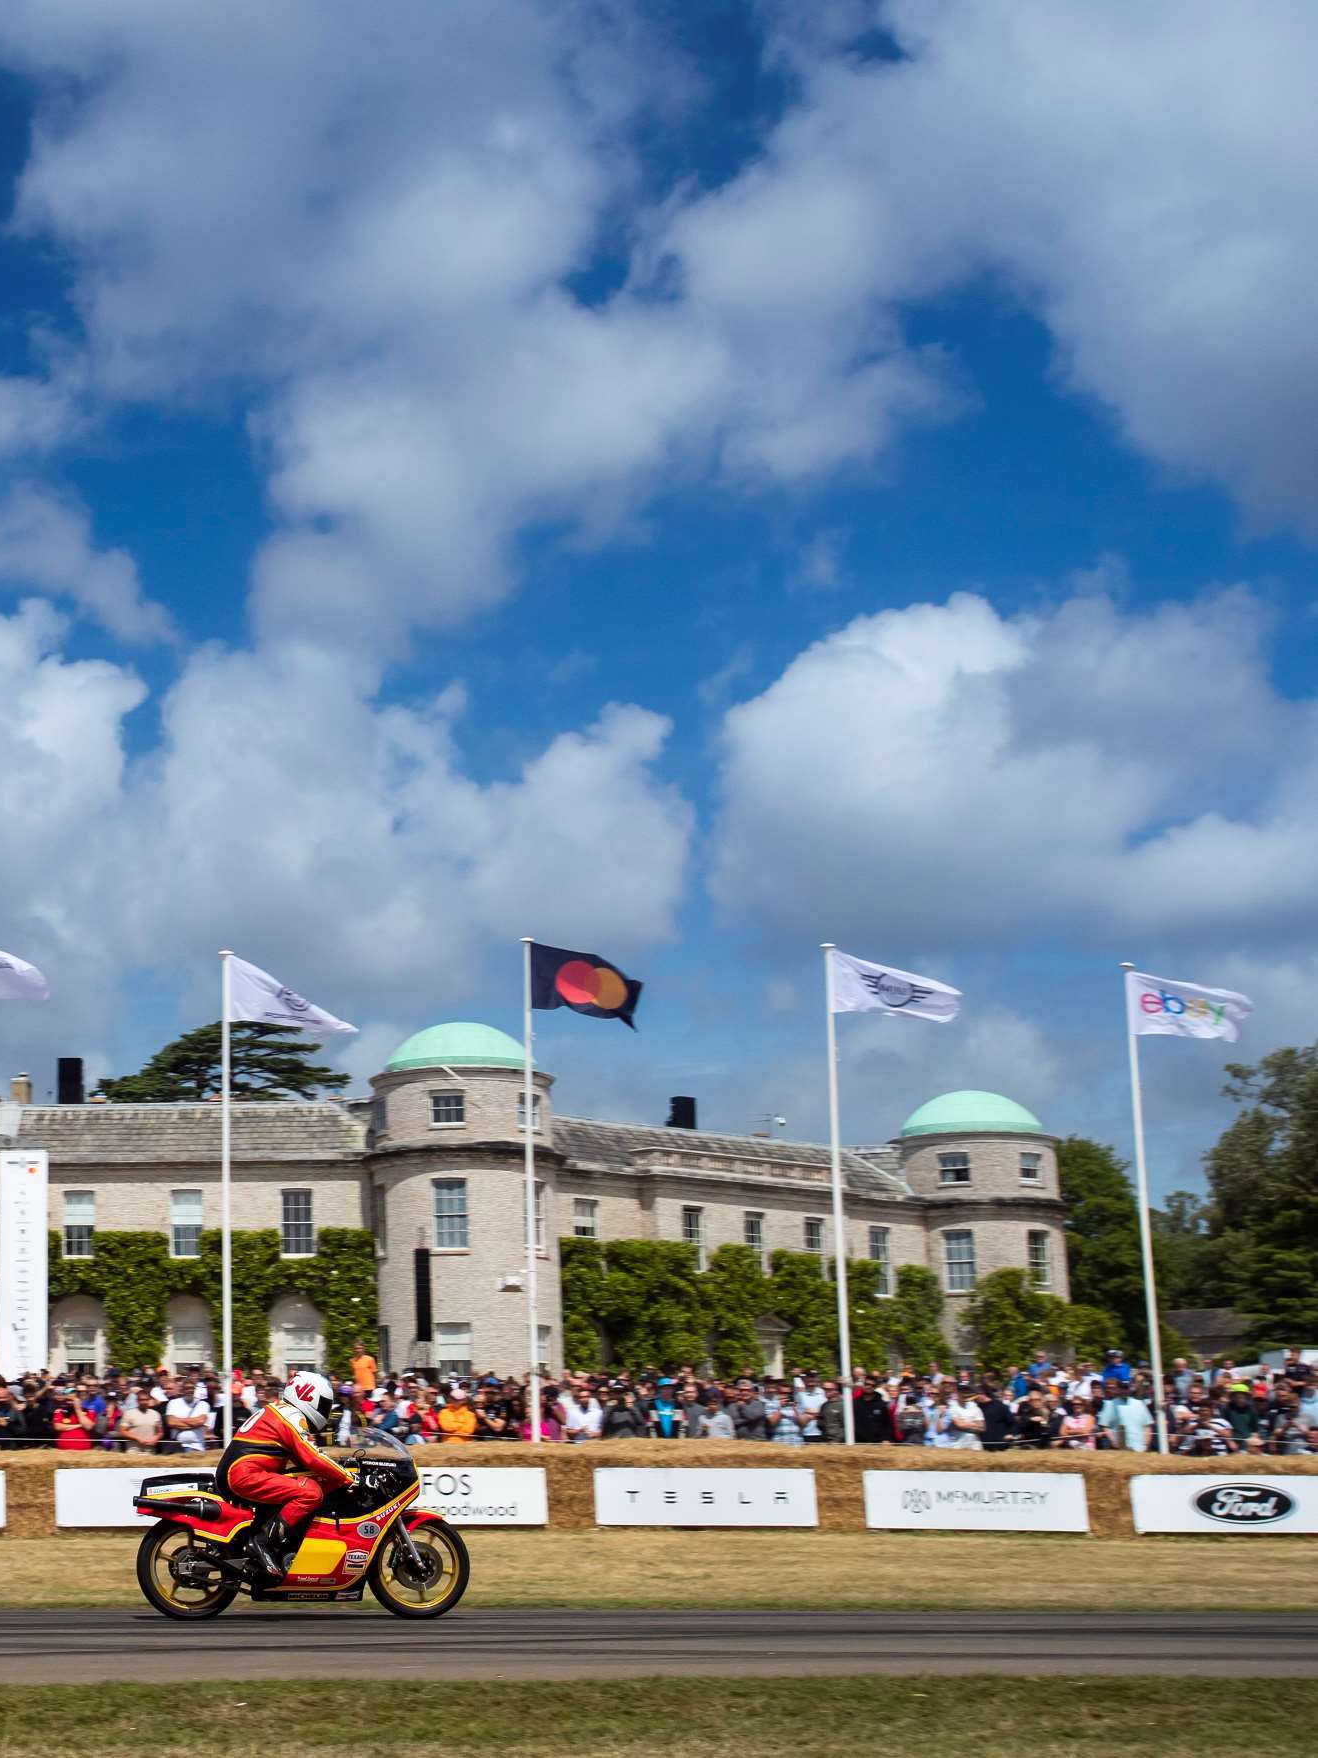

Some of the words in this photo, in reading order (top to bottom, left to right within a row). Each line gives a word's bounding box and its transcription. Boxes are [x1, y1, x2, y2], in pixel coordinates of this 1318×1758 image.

[1140, 989, 1226, 1026] ebay
[1211, 1488, 1279, 1517] Ford
[363, 1525, 375, 1535] 58
